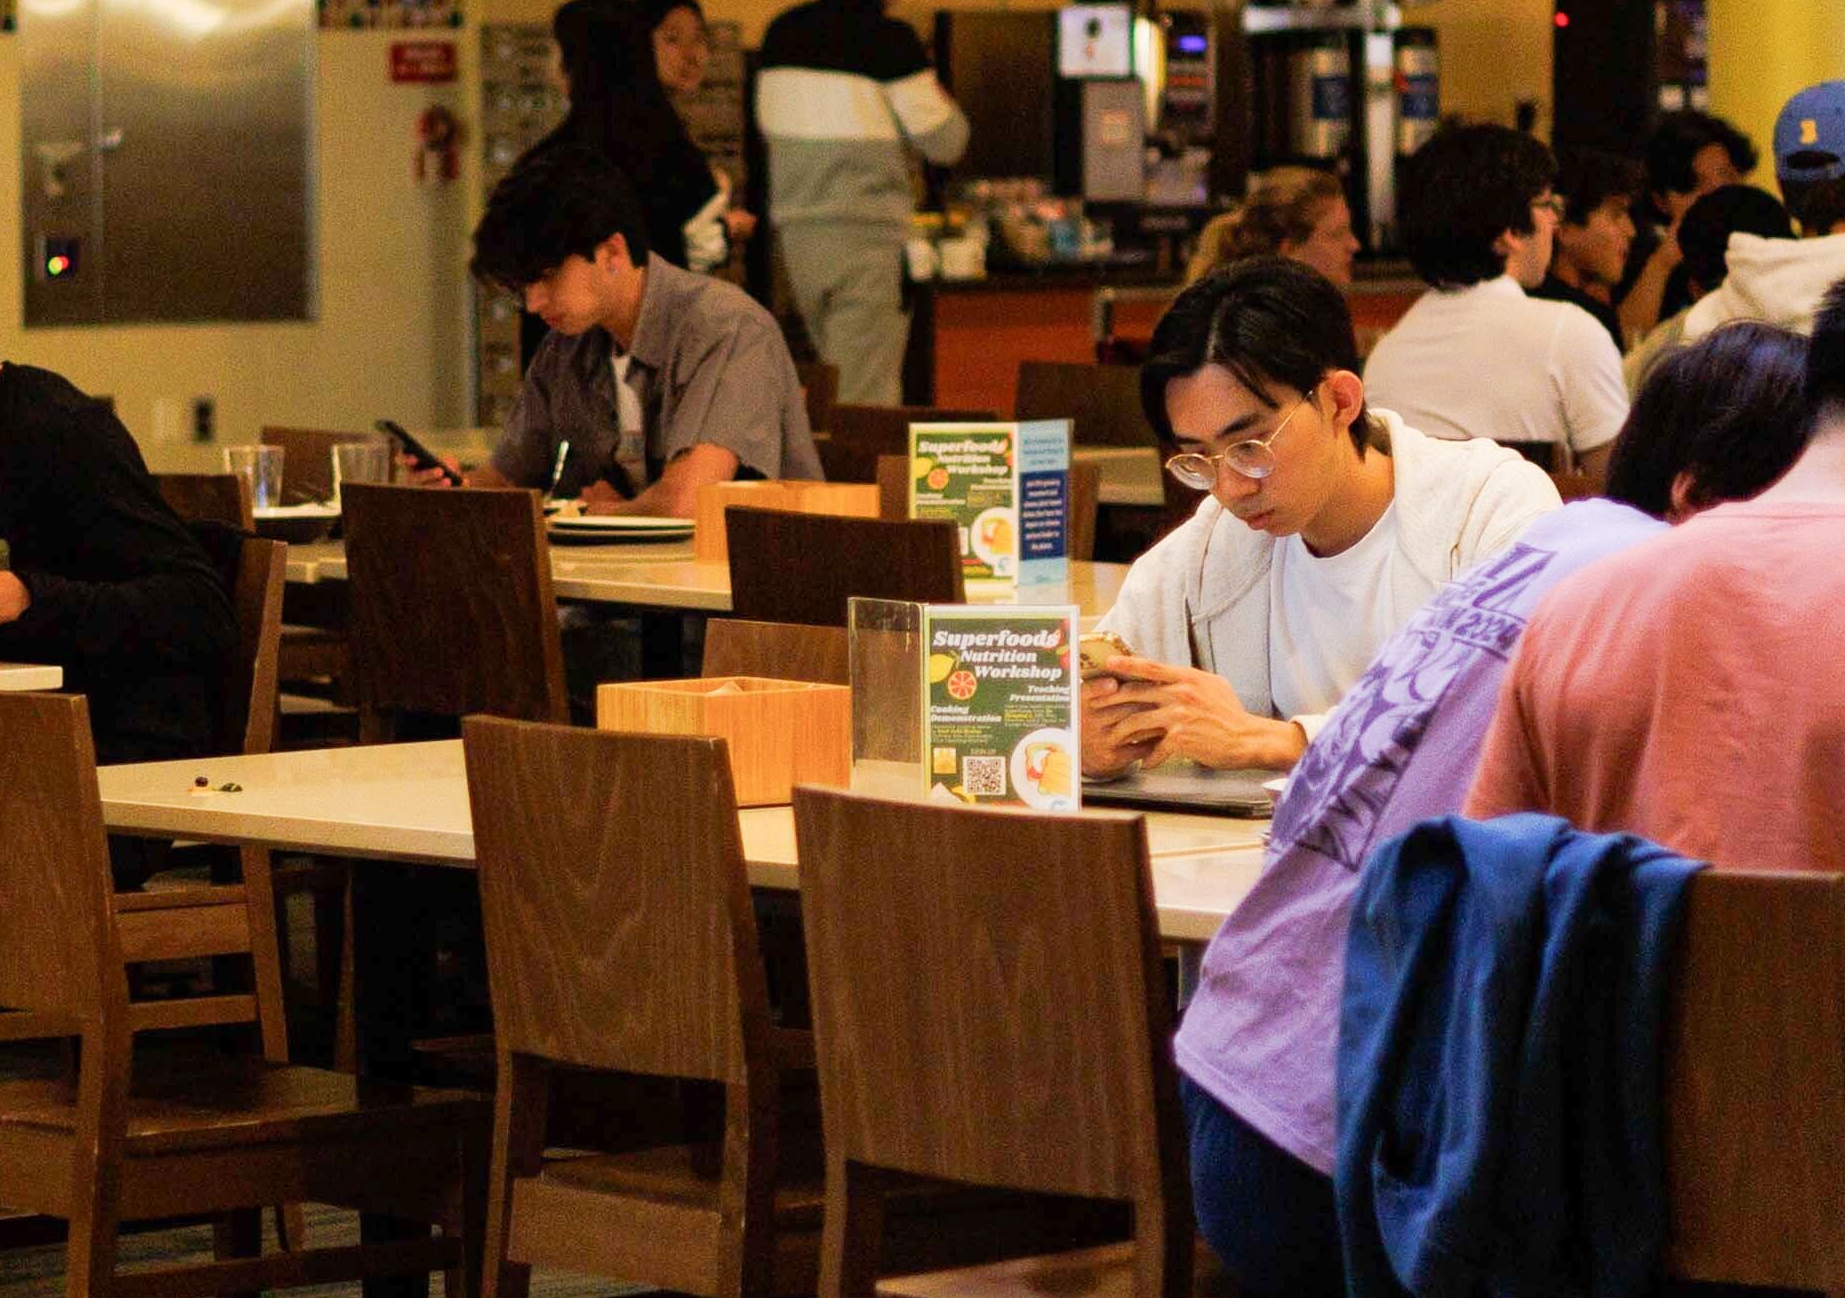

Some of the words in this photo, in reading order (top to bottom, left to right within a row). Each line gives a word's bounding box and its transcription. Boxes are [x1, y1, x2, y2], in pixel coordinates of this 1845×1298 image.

[932, 629, 1059, 650] Superfoods
[960, 649, 1038, 663] Nutrition
[974, 665, 1063, 681] Workshop
